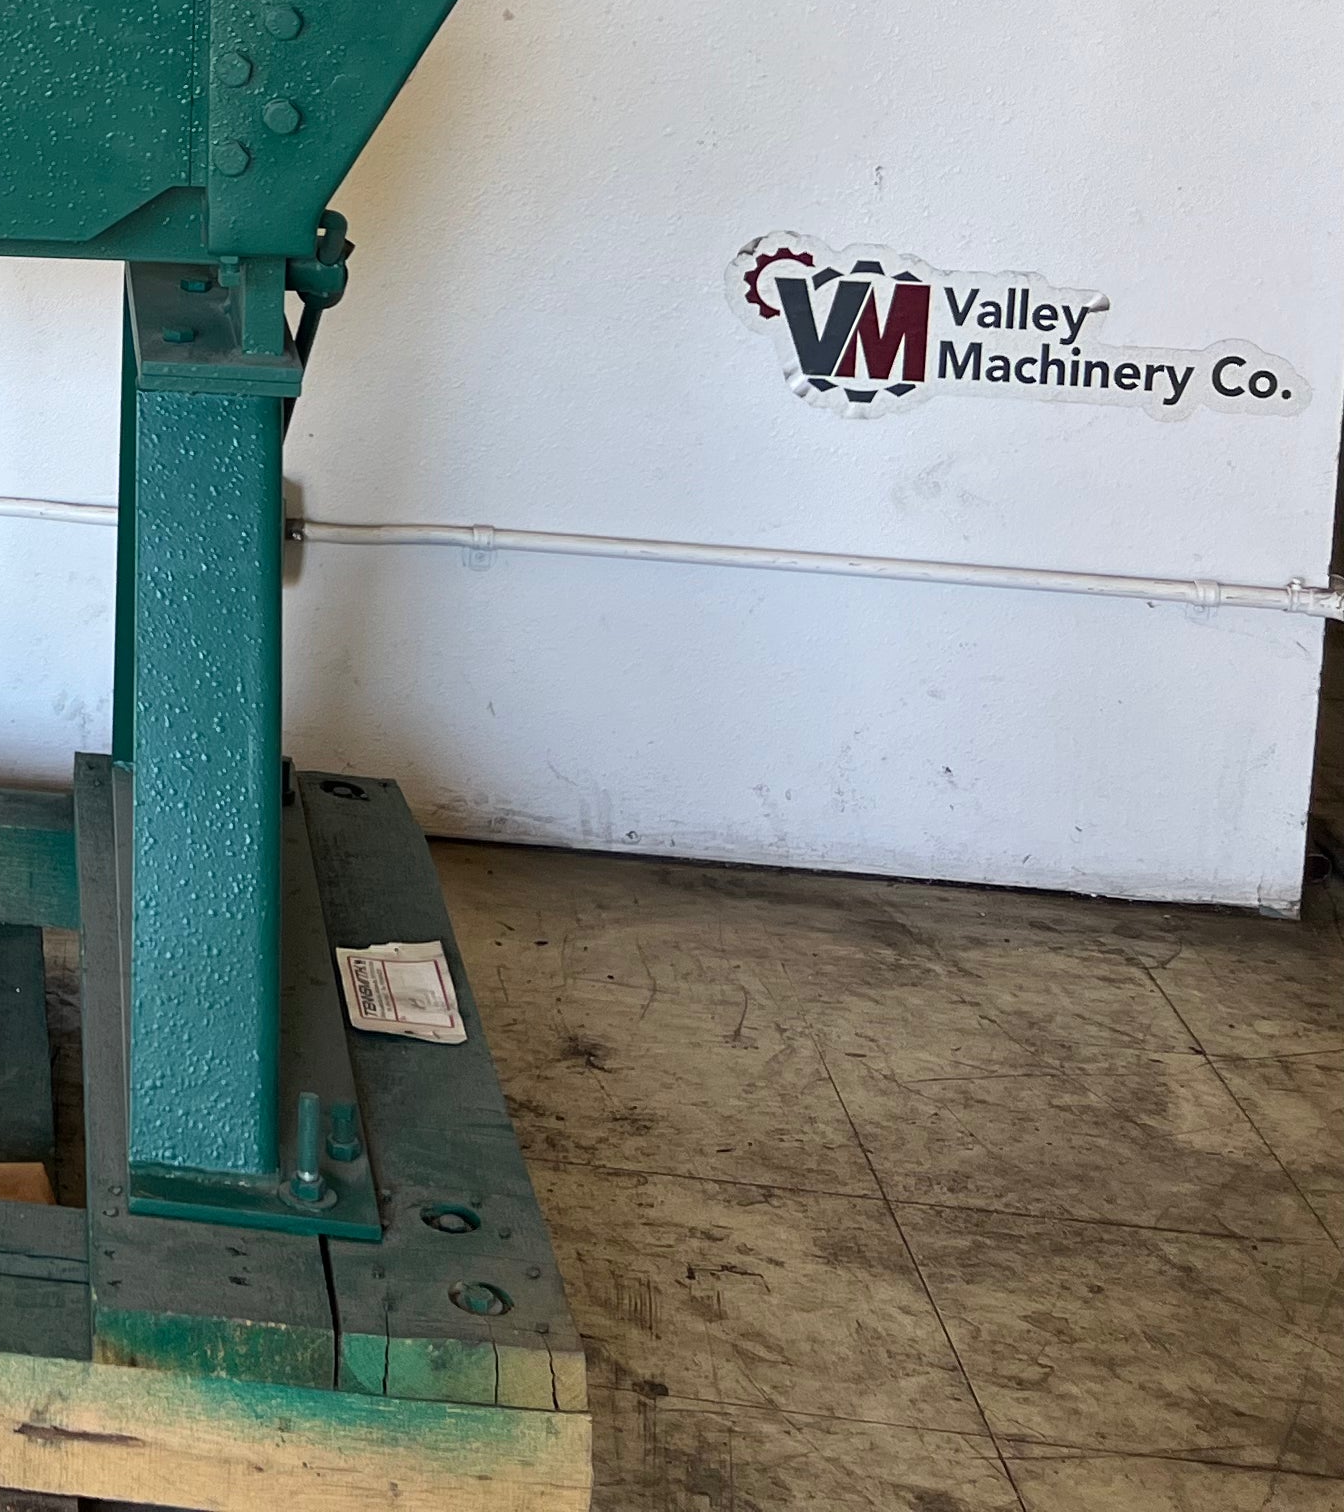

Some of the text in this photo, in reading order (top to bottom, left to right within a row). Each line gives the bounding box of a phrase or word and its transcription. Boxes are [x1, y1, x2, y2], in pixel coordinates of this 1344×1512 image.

[774, 277, 931, 383] VM
[944, 286, 1091, 346] Valley
[938, 341, 1292, 405] Machinery Co.
